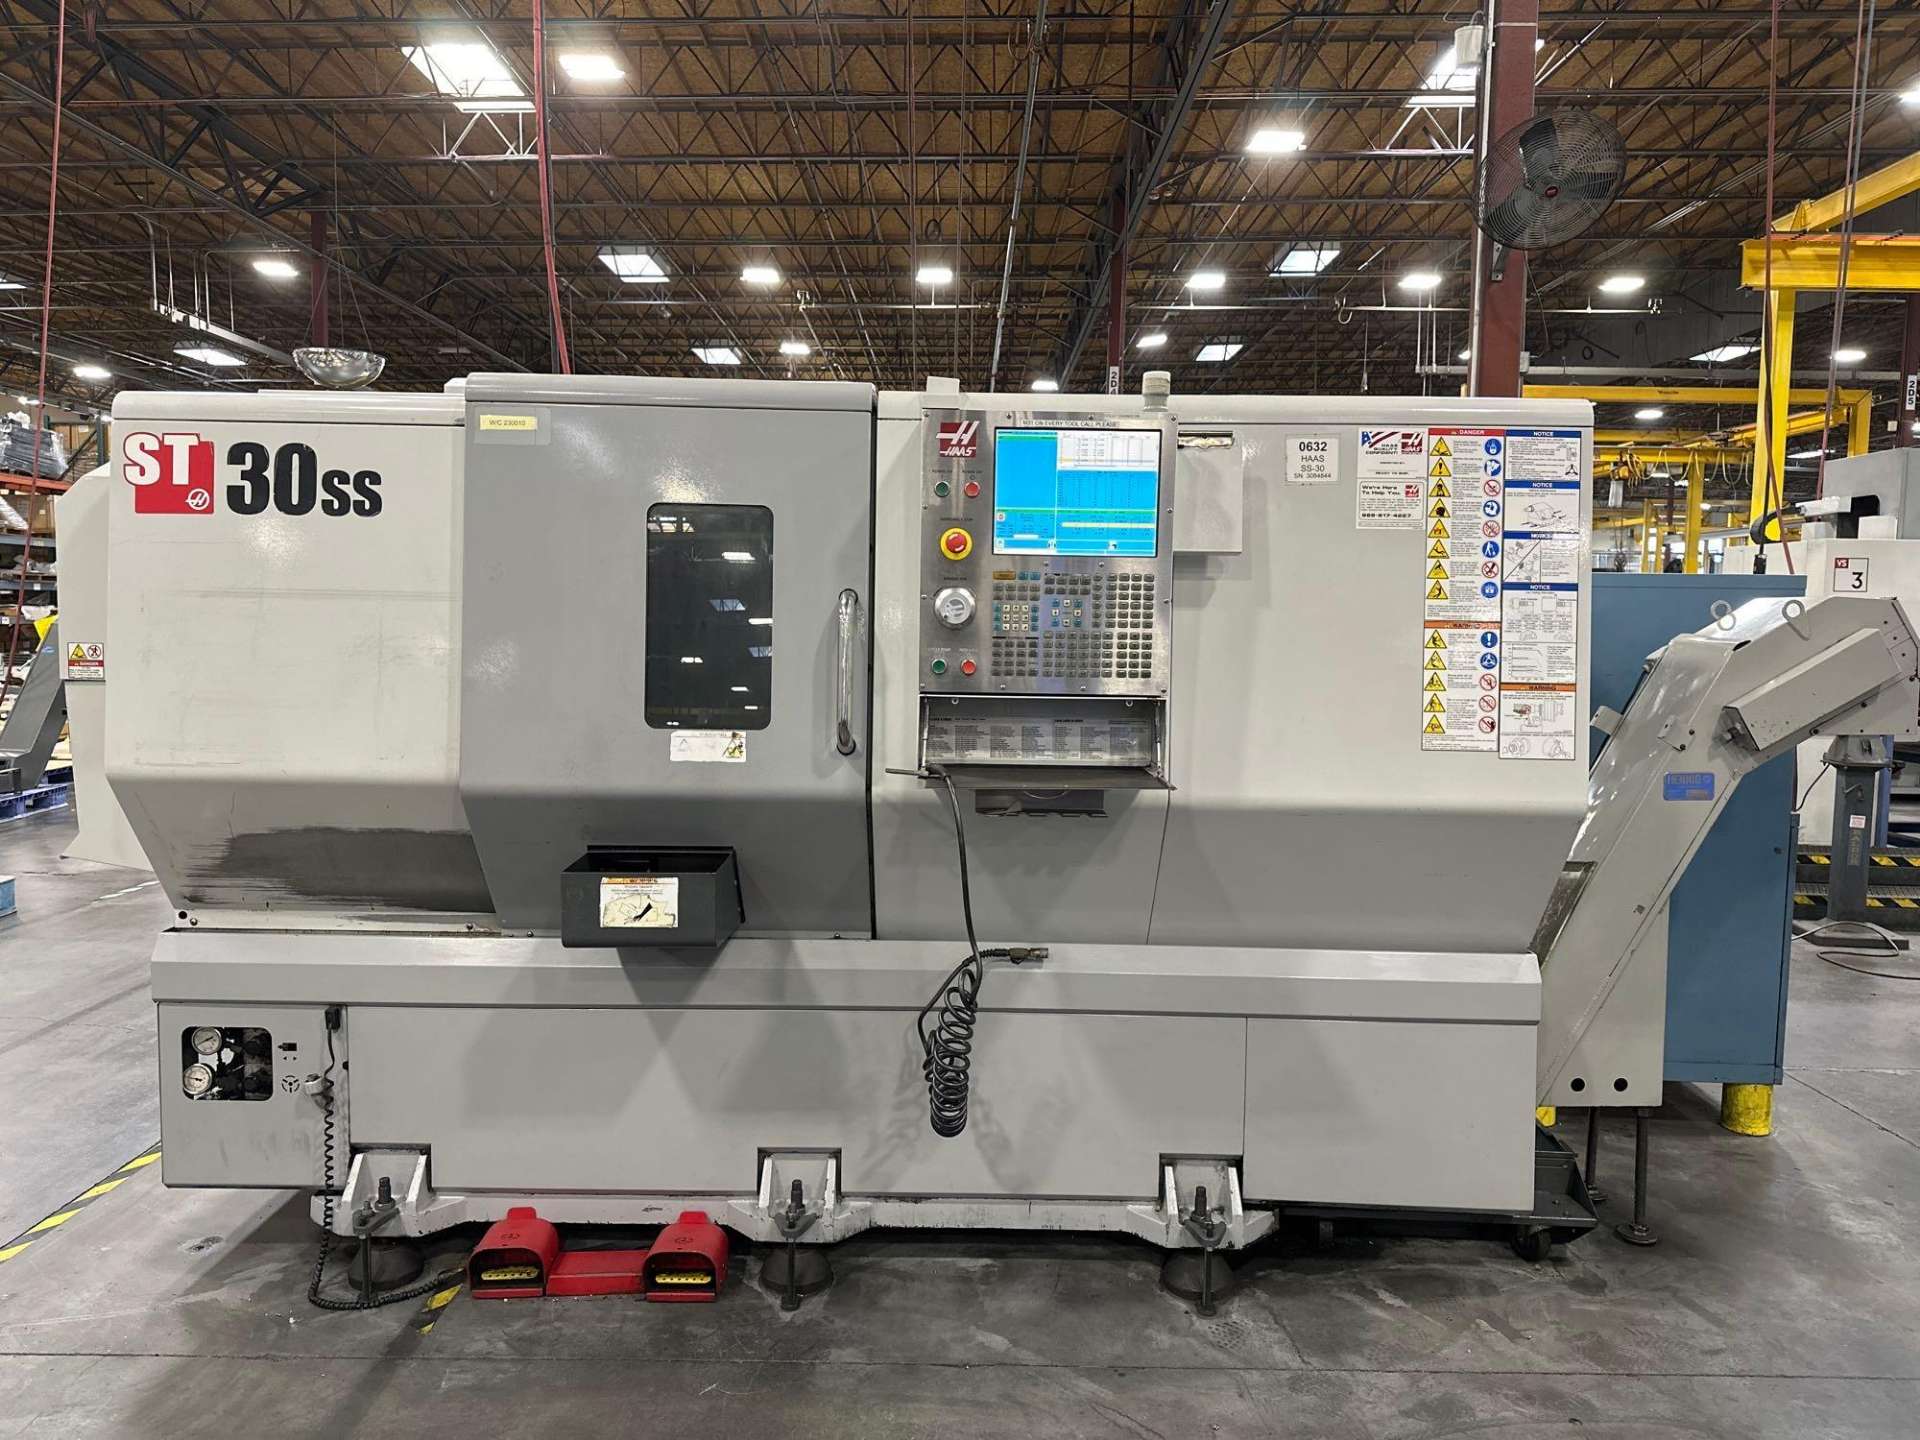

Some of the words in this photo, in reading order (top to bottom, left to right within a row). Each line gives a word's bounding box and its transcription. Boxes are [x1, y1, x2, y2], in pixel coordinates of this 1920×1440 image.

[1299, 441, 1328, 451] 0632
[939, 446, 977, 457] HAAS
[123, 432, 200, 486] ST
[1301, 454, 1325, 462] HAAS
[1300, 464, 1325, 472] SS-30
[1836, 559, 1848, 568] VS
[1852, 571, 1864, 589] 3
